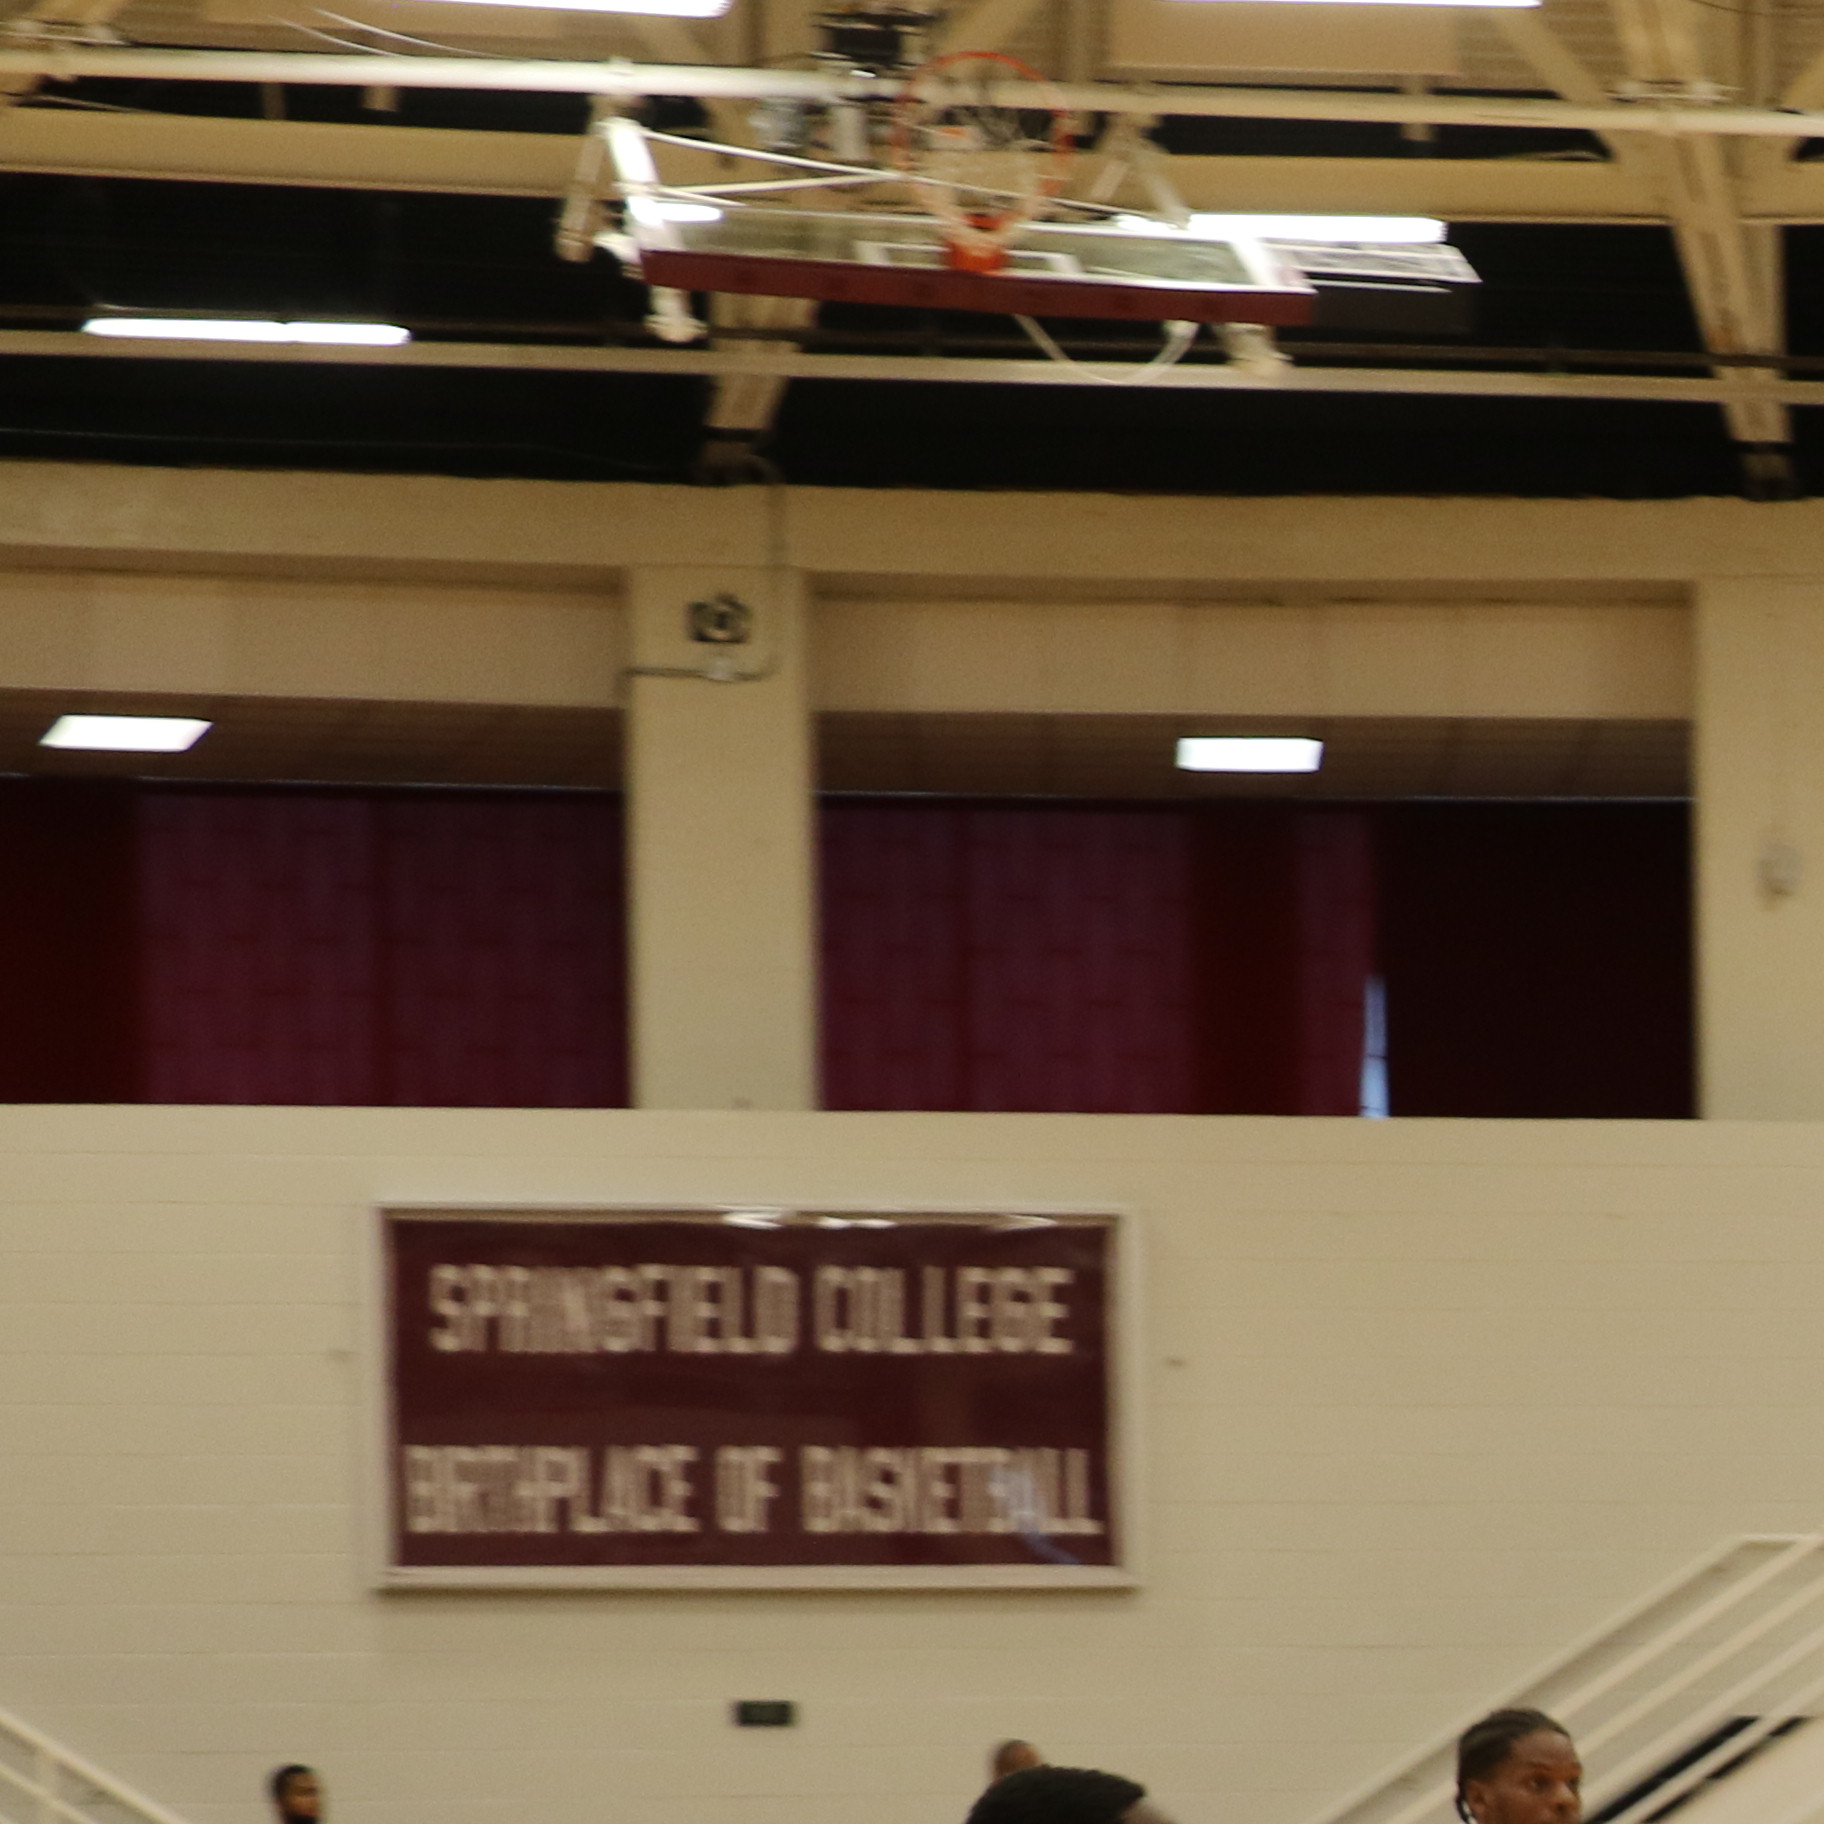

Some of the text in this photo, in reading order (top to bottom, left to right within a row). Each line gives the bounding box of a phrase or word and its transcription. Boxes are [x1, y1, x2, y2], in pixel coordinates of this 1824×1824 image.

[428, 1263, 1076, 1354] SPRINGFIELD COLLEGE
[405, 1443, 1106, 1535] BIRTHPLACE OF BASKETBALL
